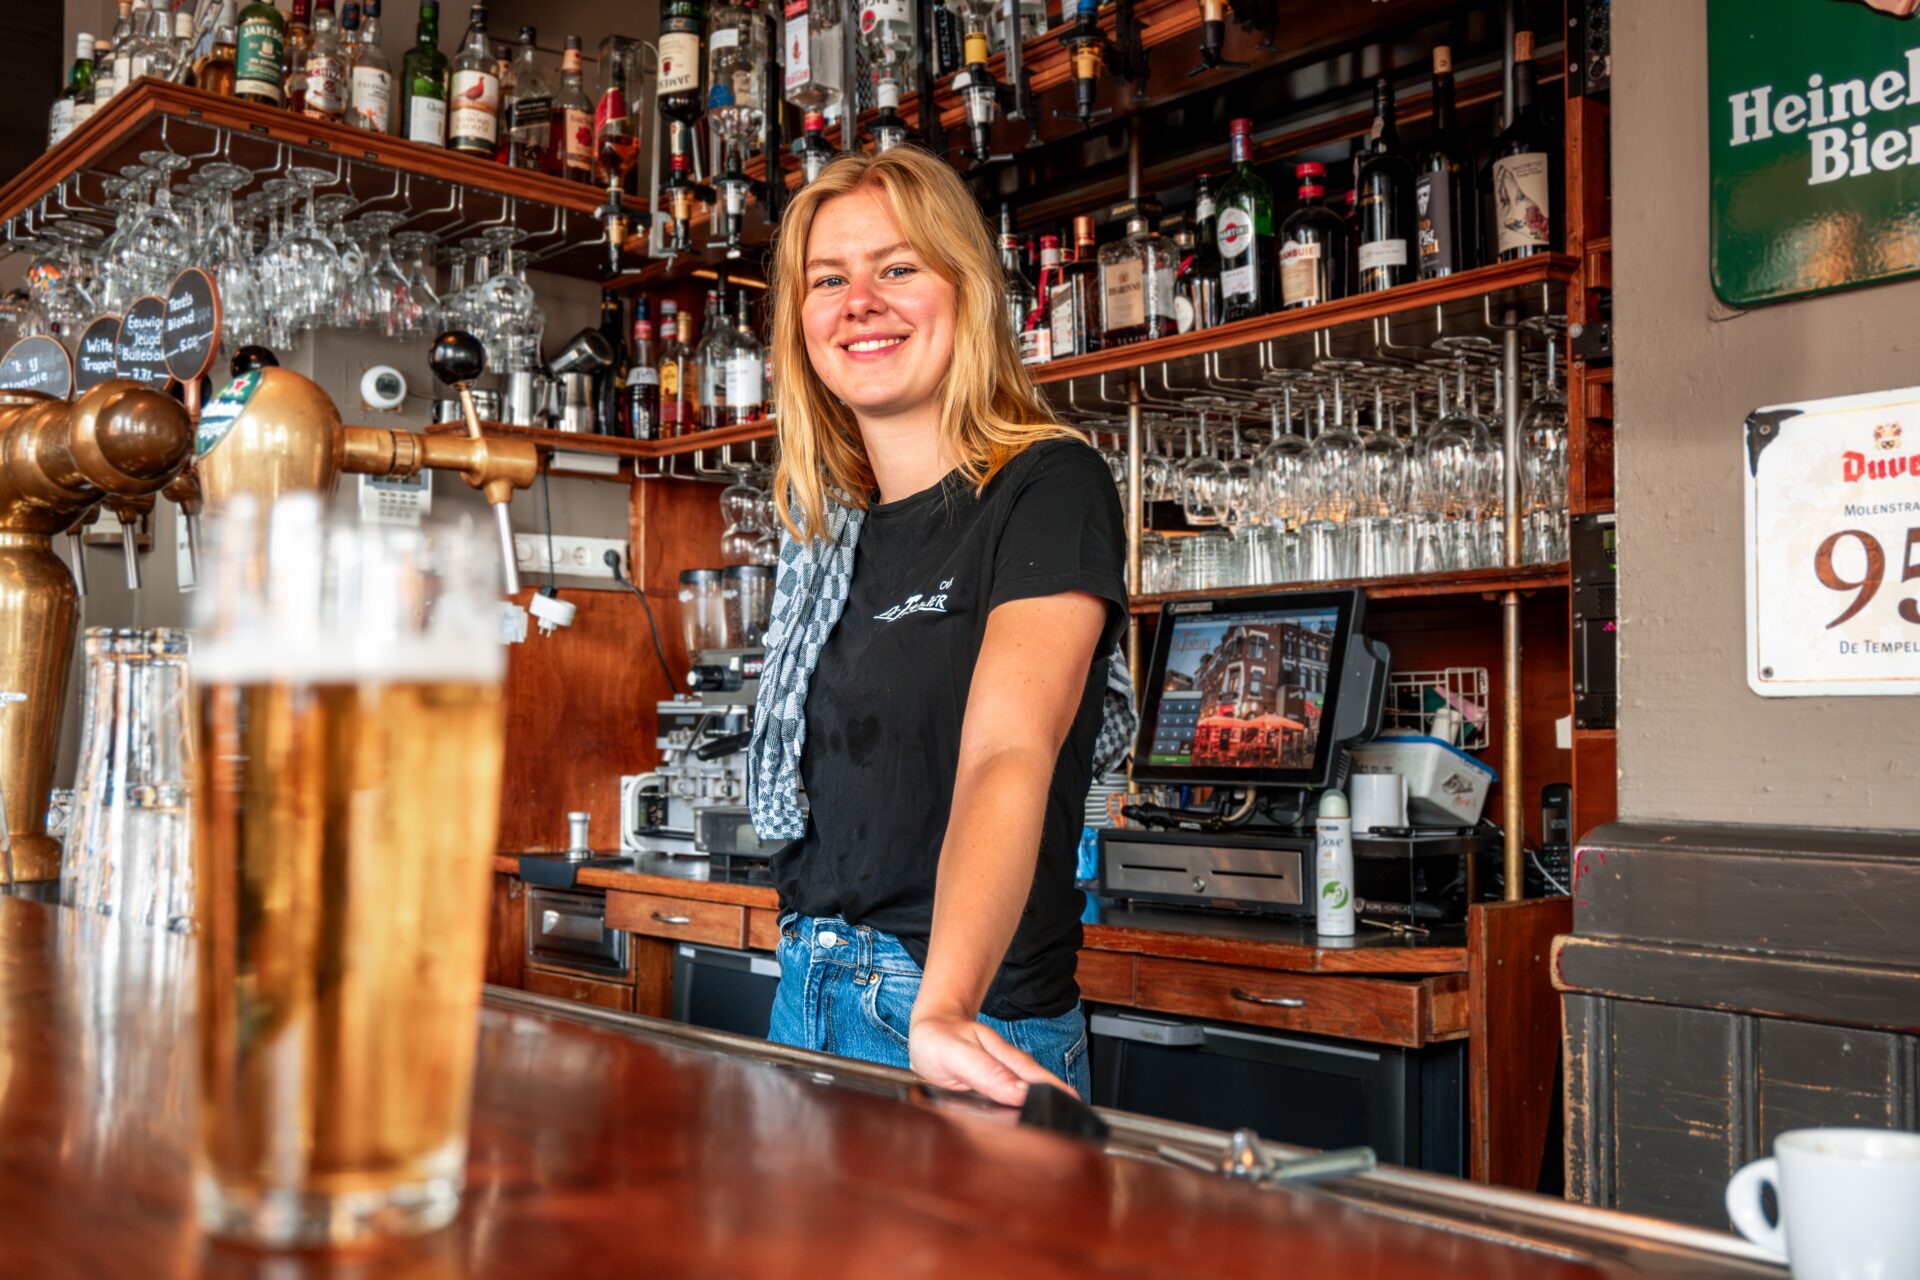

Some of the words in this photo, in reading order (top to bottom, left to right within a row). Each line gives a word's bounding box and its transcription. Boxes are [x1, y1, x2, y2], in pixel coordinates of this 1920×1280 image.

[1280, 247, 1315, 260] AMBUIE
[127, 314, 163, 330] Eeuwig
[86, 338, 113, 352] Witte
[82, 357, 116, 373] Trappis
